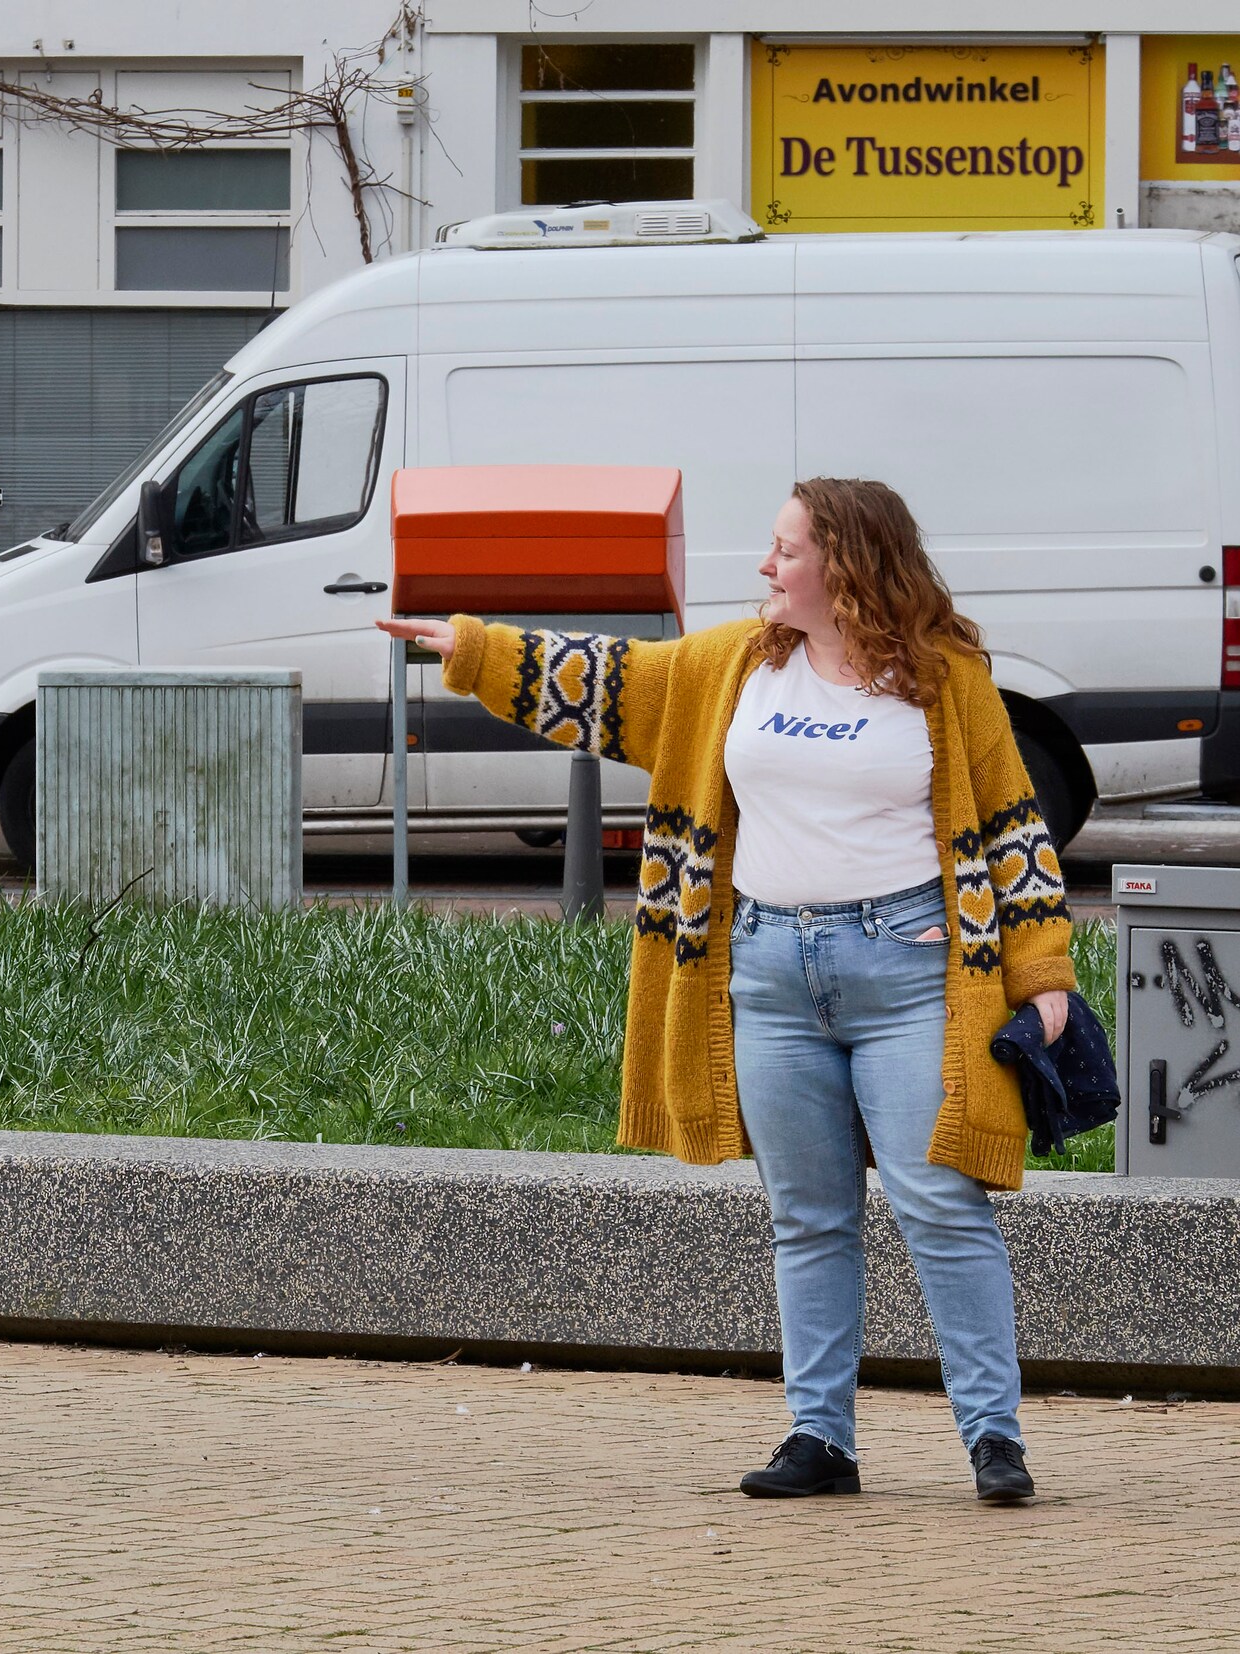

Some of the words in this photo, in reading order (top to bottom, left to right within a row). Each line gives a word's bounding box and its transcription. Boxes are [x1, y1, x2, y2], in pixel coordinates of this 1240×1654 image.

[812, 76, 1040, 103] Avondwinkel
[780, 137, 835, 176] De
[846, 137, 1084, 188] Tussenstop
[758, 712, 868, 740] Nice!
[1126, 882, 1152, 891] STAKA
